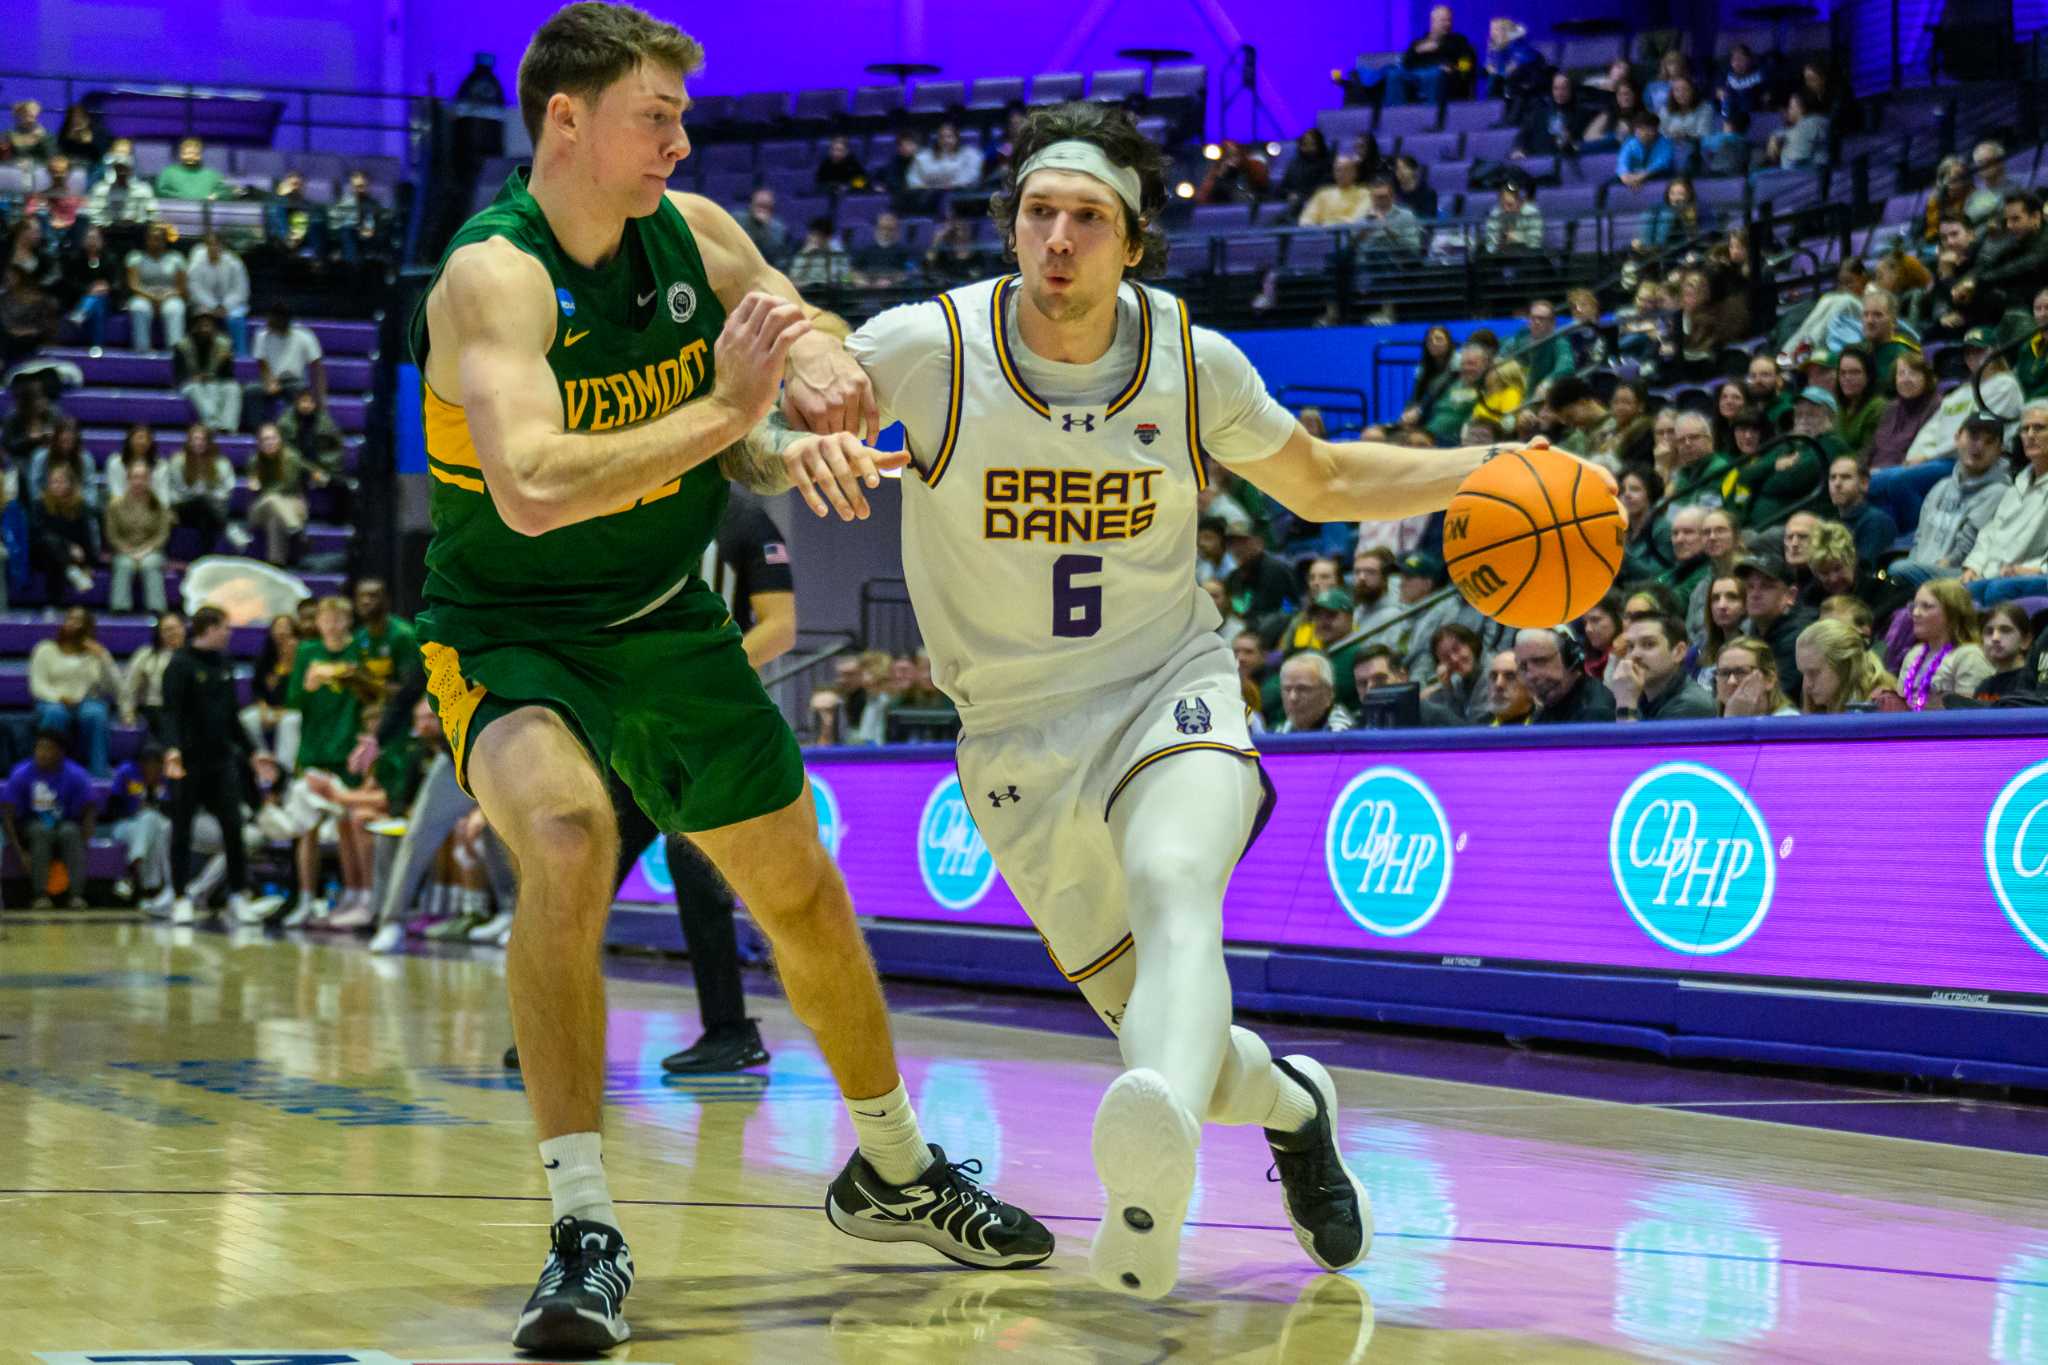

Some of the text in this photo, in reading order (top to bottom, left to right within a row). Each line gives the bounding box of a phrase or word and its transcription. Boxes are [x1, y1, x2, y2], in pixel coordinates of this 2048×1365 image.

[564, 338, 708, 431] VERMONT
[984, 466, 1165, 505] GREAT
[984, 501, 1157, 544] DANES
[1052, 554, 1103, 637] 6
